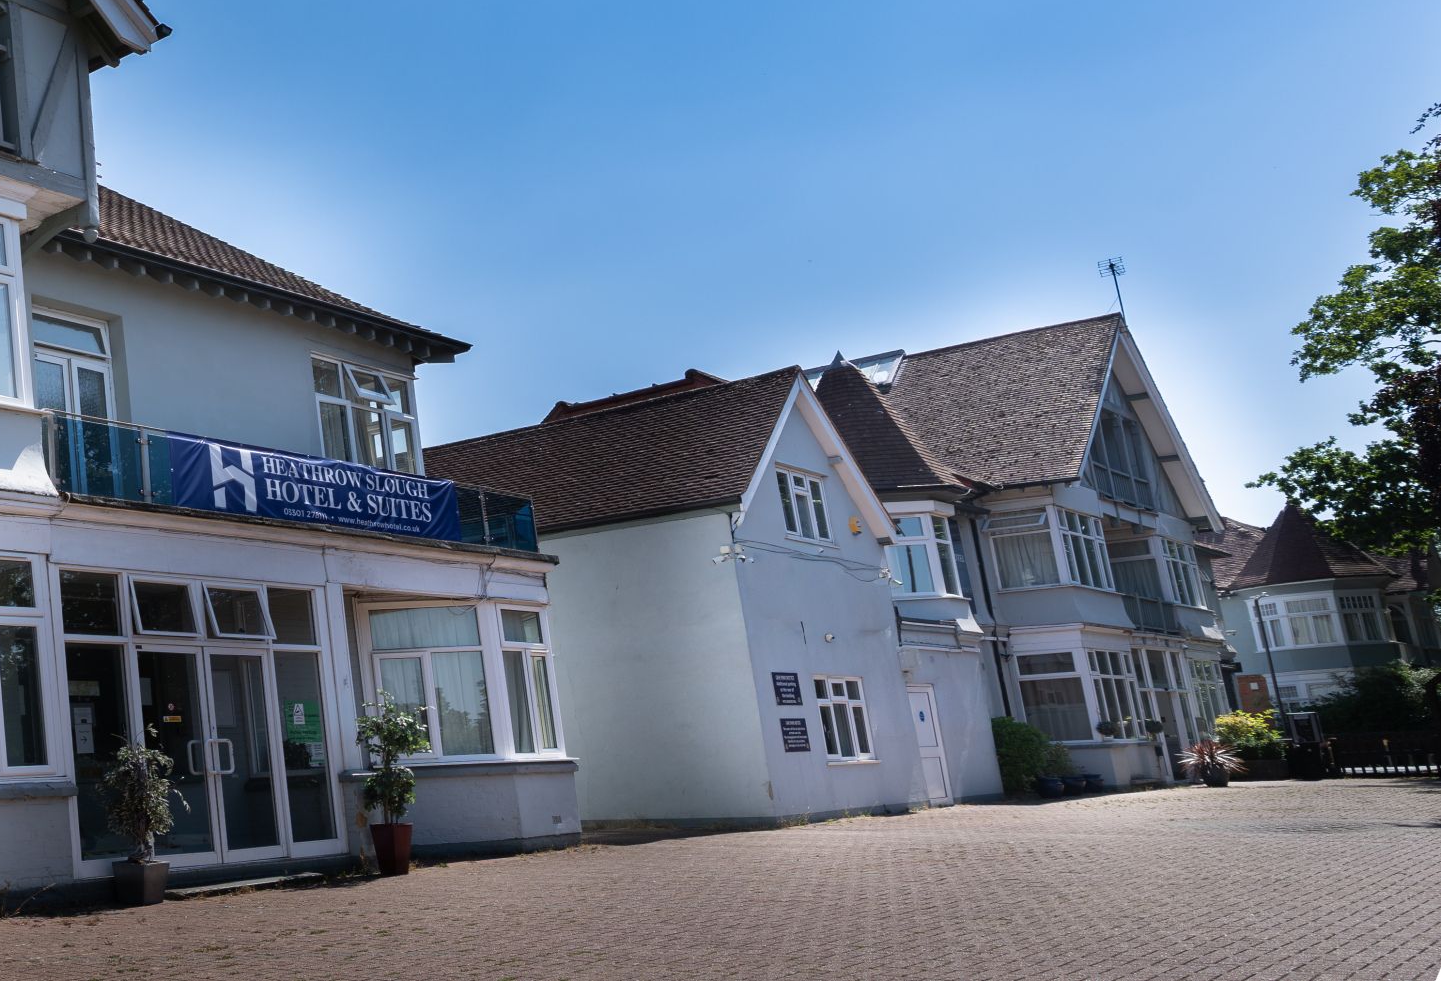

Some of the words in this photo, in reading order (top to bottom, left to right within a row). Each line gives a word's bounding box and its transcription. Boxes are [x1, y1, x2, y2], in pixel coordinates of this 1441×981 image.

[261, 456, 362, 488] HEATHROW
[366, 474, 430, 499] SLOUGH
[265, 478, 342, 509] HOTEL
[347, 491, 363, 513] &
[367, 493, 432, 523] SUITES
[338, 516, 421, 533] www.heathrowhotel.co.uk
